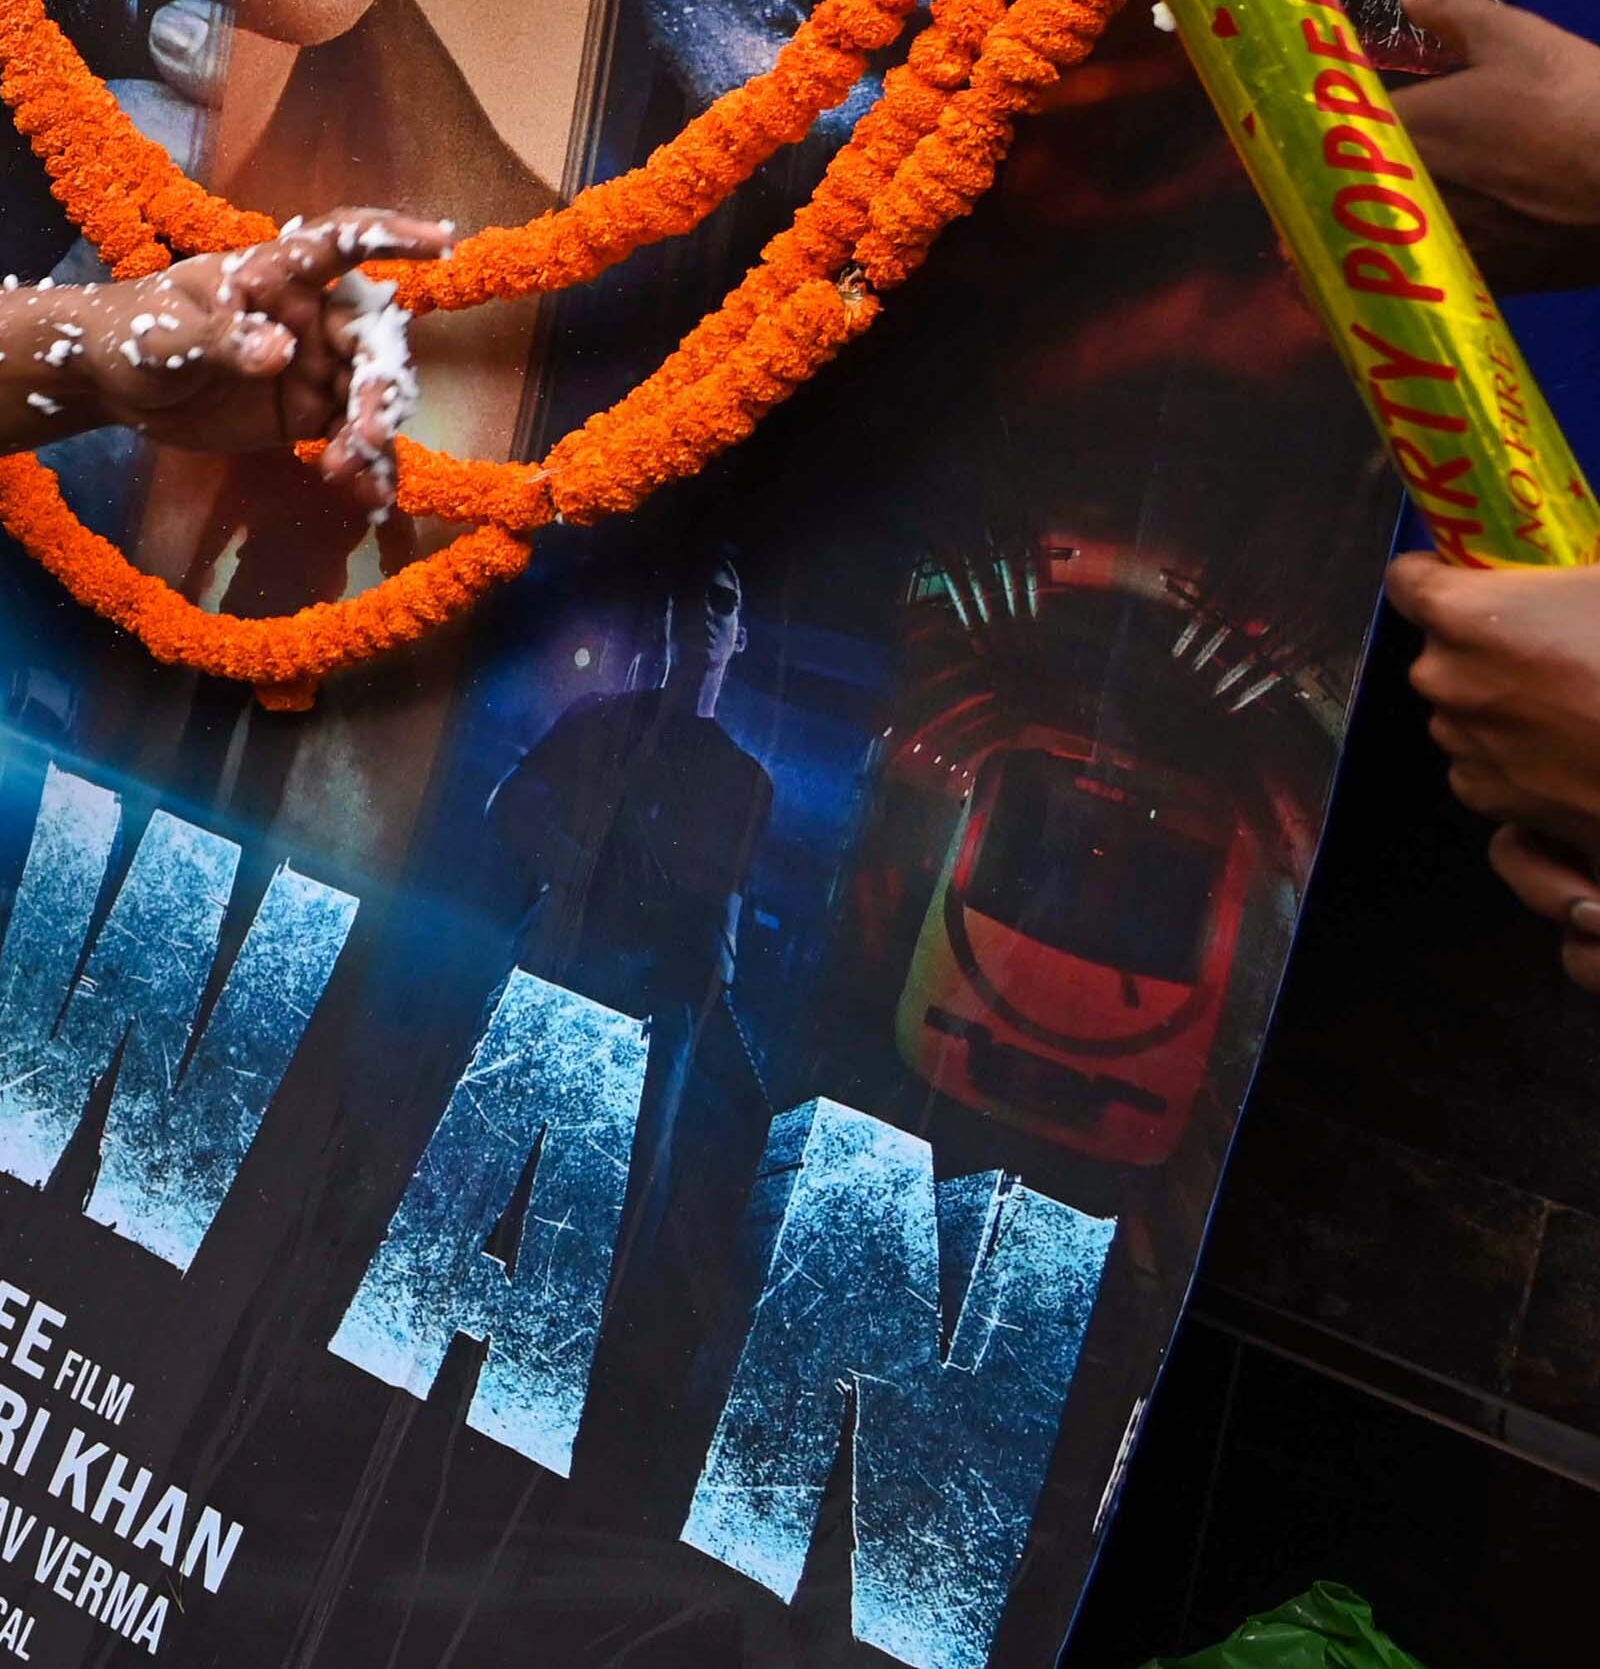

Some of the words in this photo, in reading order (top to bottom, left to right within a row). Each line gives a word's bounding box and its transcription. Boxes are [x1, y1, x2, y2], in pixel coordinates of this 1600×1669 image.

[53, 1350, 135, 1425] FILM
[47, 1427, 244, 1594] KHAN
[34, 1527, 170, 1656] VERMA
